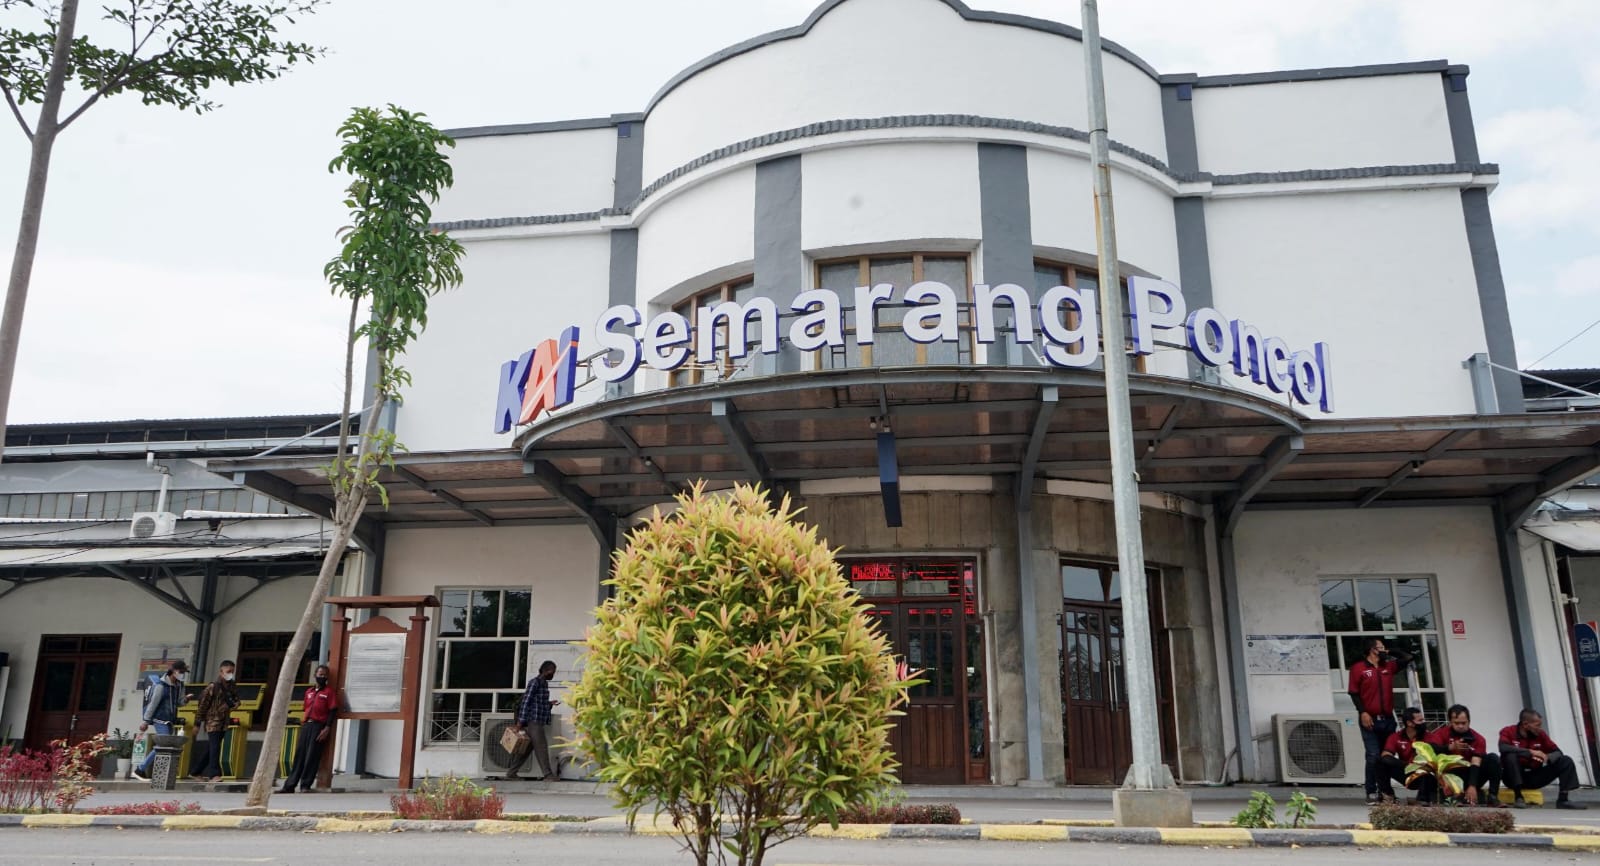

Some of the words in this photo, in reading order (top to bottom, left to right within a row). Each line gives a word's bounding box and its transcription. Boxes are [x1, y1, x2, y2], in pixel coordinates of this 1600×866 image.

[495, 326, 580, 434] KAI
[592, 280, 1099, 383] Semarang
[1127, 275, 1335, 413] Poncol
